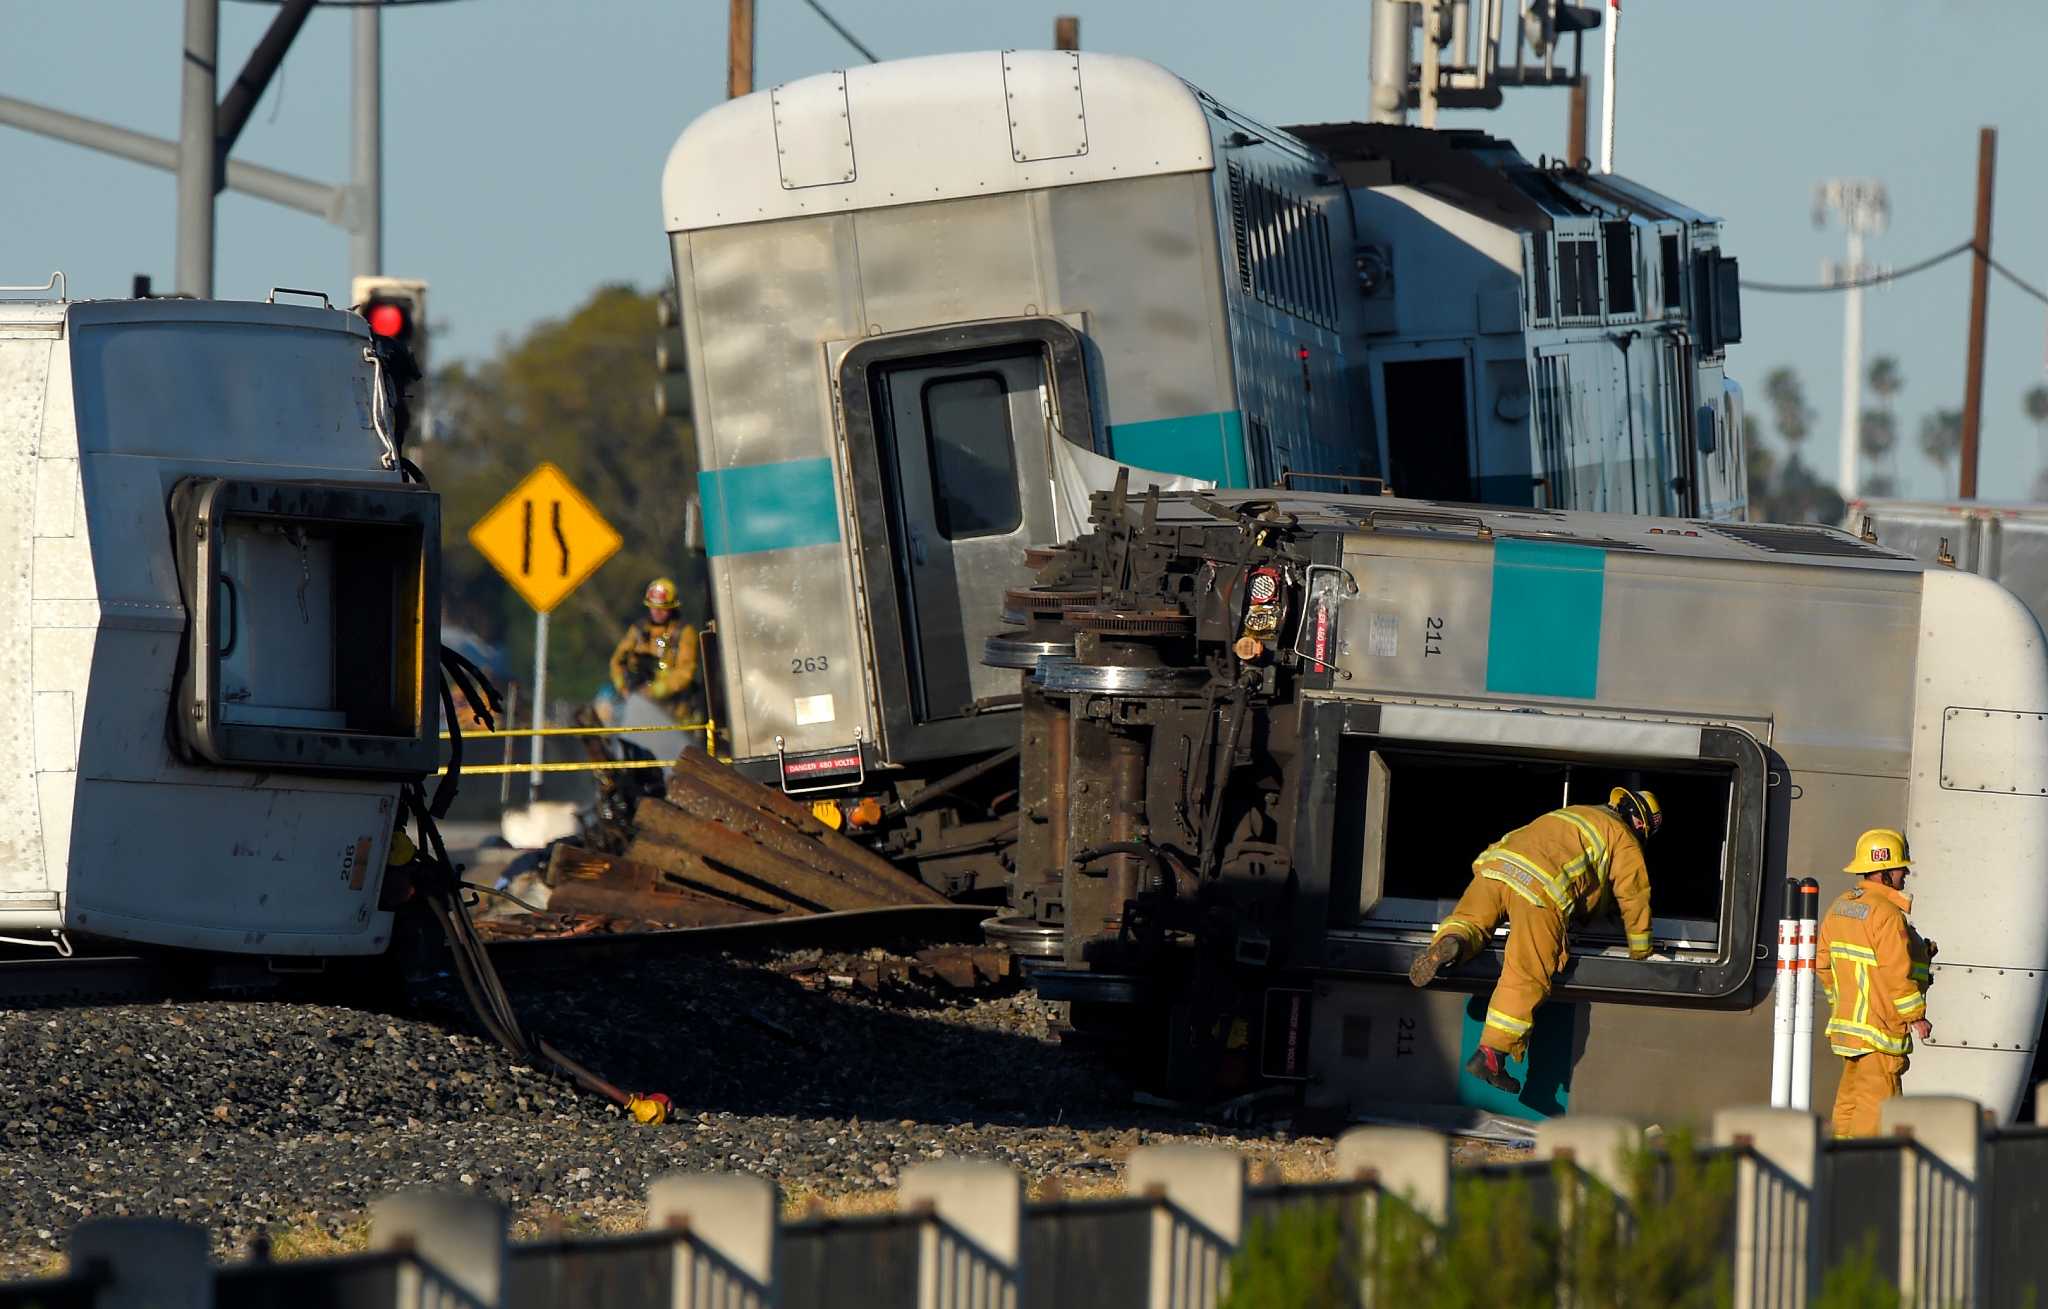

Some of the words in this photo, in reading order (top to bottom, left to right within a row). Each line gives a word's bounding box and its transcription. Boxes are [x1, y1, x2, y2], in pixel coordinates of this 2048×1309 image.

[1424, 617, 1444, 657] 211
[791, 656, 829, 674] 263
[788, 762, 817, 773] DANGER
[834, 758, 855, 768] VOLTS
[1396, 1017, 1415, 1057] 211
